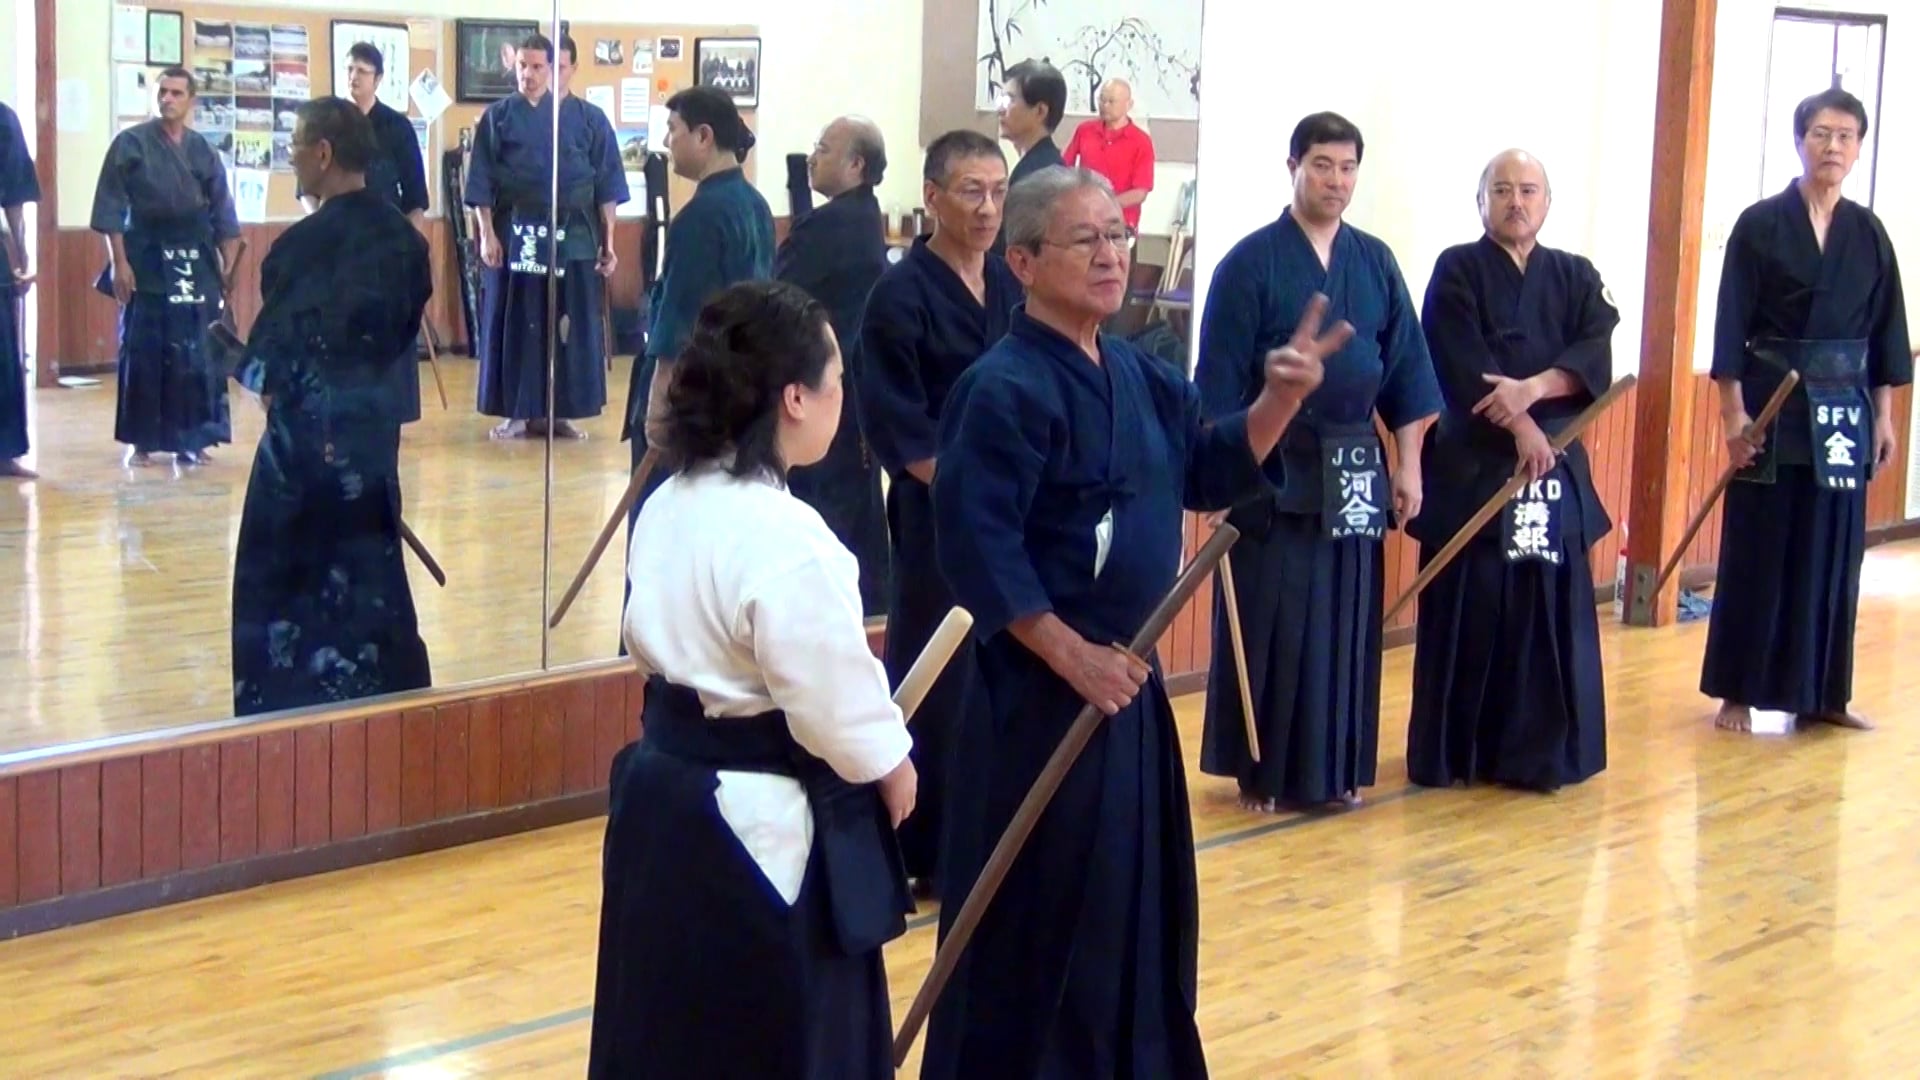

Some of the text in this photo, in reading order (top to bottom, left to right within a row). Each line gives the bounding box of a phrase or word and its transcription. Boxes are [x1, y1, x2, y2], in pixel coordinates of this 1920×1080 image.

[1816, 405, 1861, 426] SFV
[1331, 447, 1381, 466] JCI
[1824, 431, 1857, 466] 金
[1338, 469, 1380, 526] 河合
[1332, 526, 1382, 538] KAWAI
